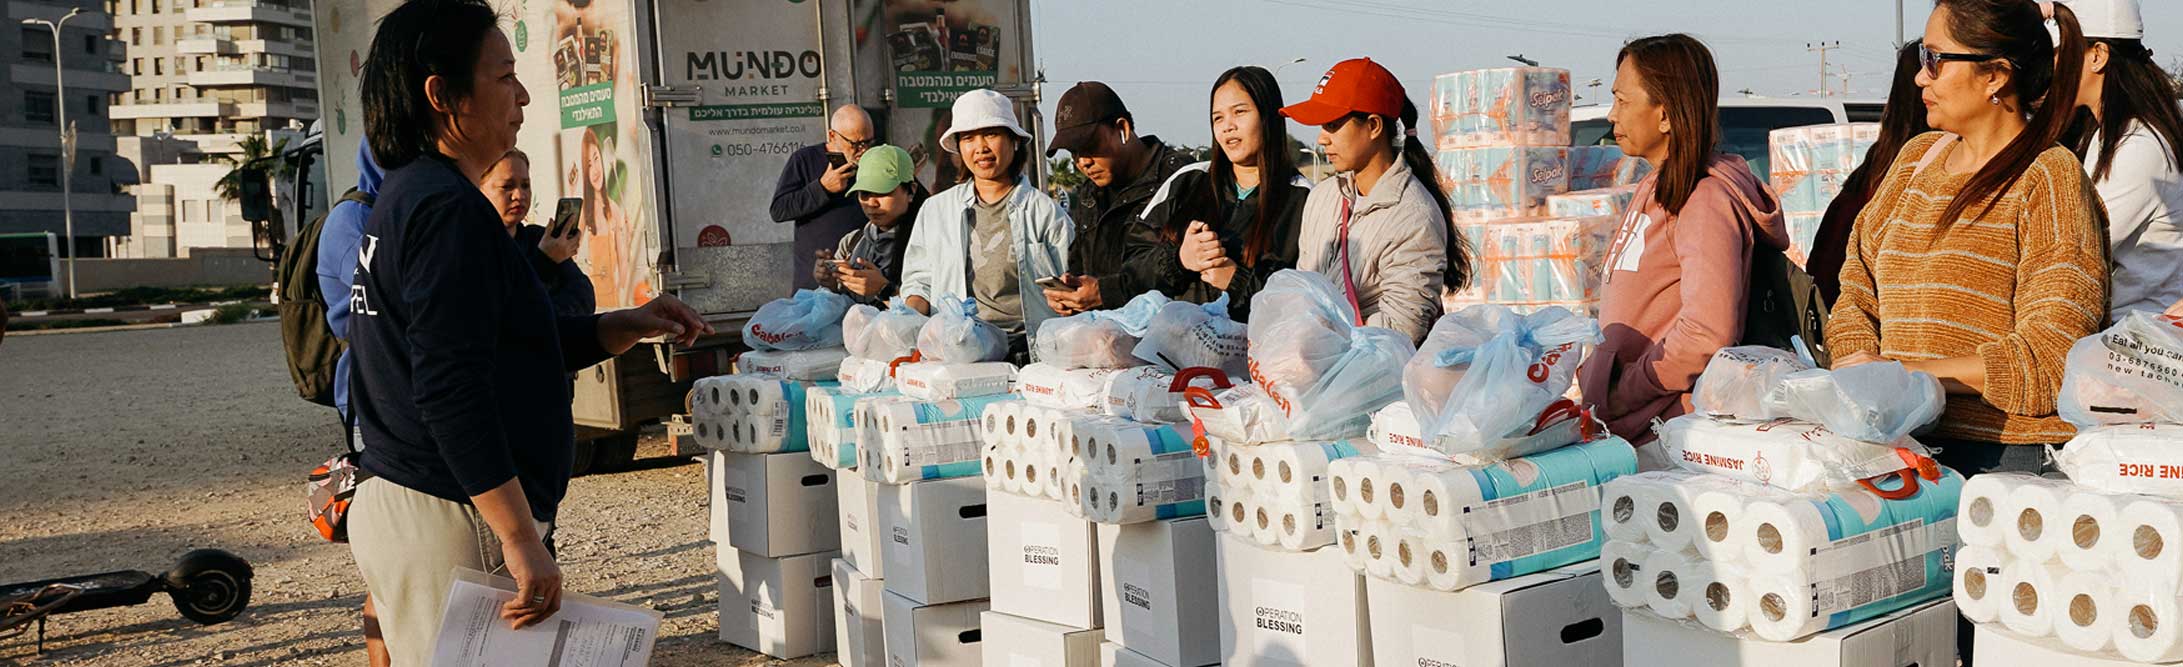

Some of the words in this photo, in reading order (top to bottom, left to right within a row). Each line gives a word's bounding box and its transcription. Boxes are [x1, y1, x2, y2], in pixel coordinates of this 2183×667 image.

[687, 50, 821, 80] MUNDO
[899, 75, 953, 87] מהמטבח
[956, 75, 995, 87] טעמים
[725, 85, 789, 97] MARKET
[920, 89, 962, 103] אילנדי
[1531, 89, 1564, 107] Selpak
[694, 108, 723, 119] אליכם
[725, 107, 749, 118] בדרך
[751, 106, 783, 117] עולמית
[785, 104, 823, 117] קולינריה
[708, 124, 806, 137] www.mundomarket.co.il
[1531, 165, 1563, 183] Selpak
[2112, 334, 2129, 348] Eat
[2130, 340, 2143, 352] all
[2144, 345, 2164, 356] you
[2107, 362, 2133, 375] new
[1023, 544, 1059, 556] OPERATION
[1024, 554, 1059, 566] BLESSING
[1124, 591, 1151, 611] BLESSING
[1255, 606, 1303, 624] OPERATION
[1256, 617, 1303, 635] BLESSING
